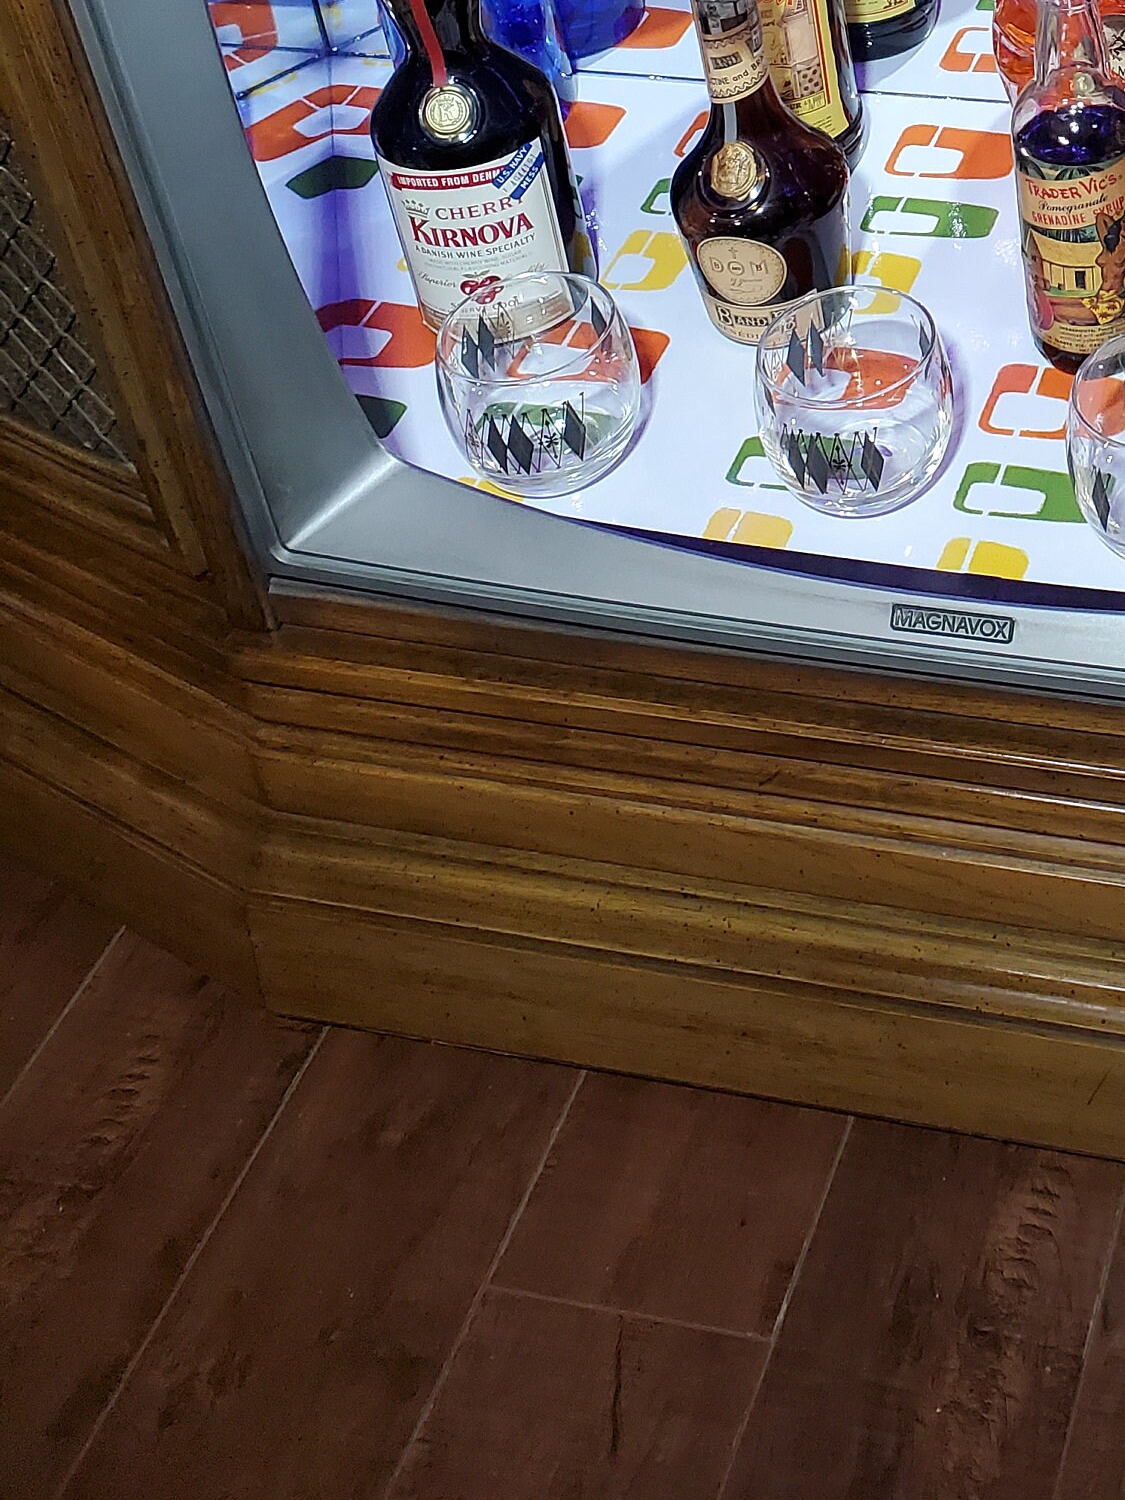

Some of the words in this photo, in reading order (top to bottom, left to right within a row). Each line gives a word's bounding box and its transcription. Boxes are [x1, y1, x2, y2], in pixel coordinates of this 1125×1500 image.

[732, 69, 749, 82] and
[509, 146, 528, 170] NAVY
[441, 175, 469, 187] FROM
[520, 166, 539, 190] MESS
[1025, 178, 1082, 200] TRADER
[1031, 210, 1086, 226] GRENADINE
[1092, 195, 1125, 217] SYRUP
[1038, 192, 1108, 214] Pomegranate
[408, 211, 535, 248] KIRNOVA
[421, 246, 453, 259] DANISH
[455, 249, 483, 259] WINE
[486, 232, 536, 256] SPECIALTY
[894, 606, 1010, 640] MAGNAVOX
